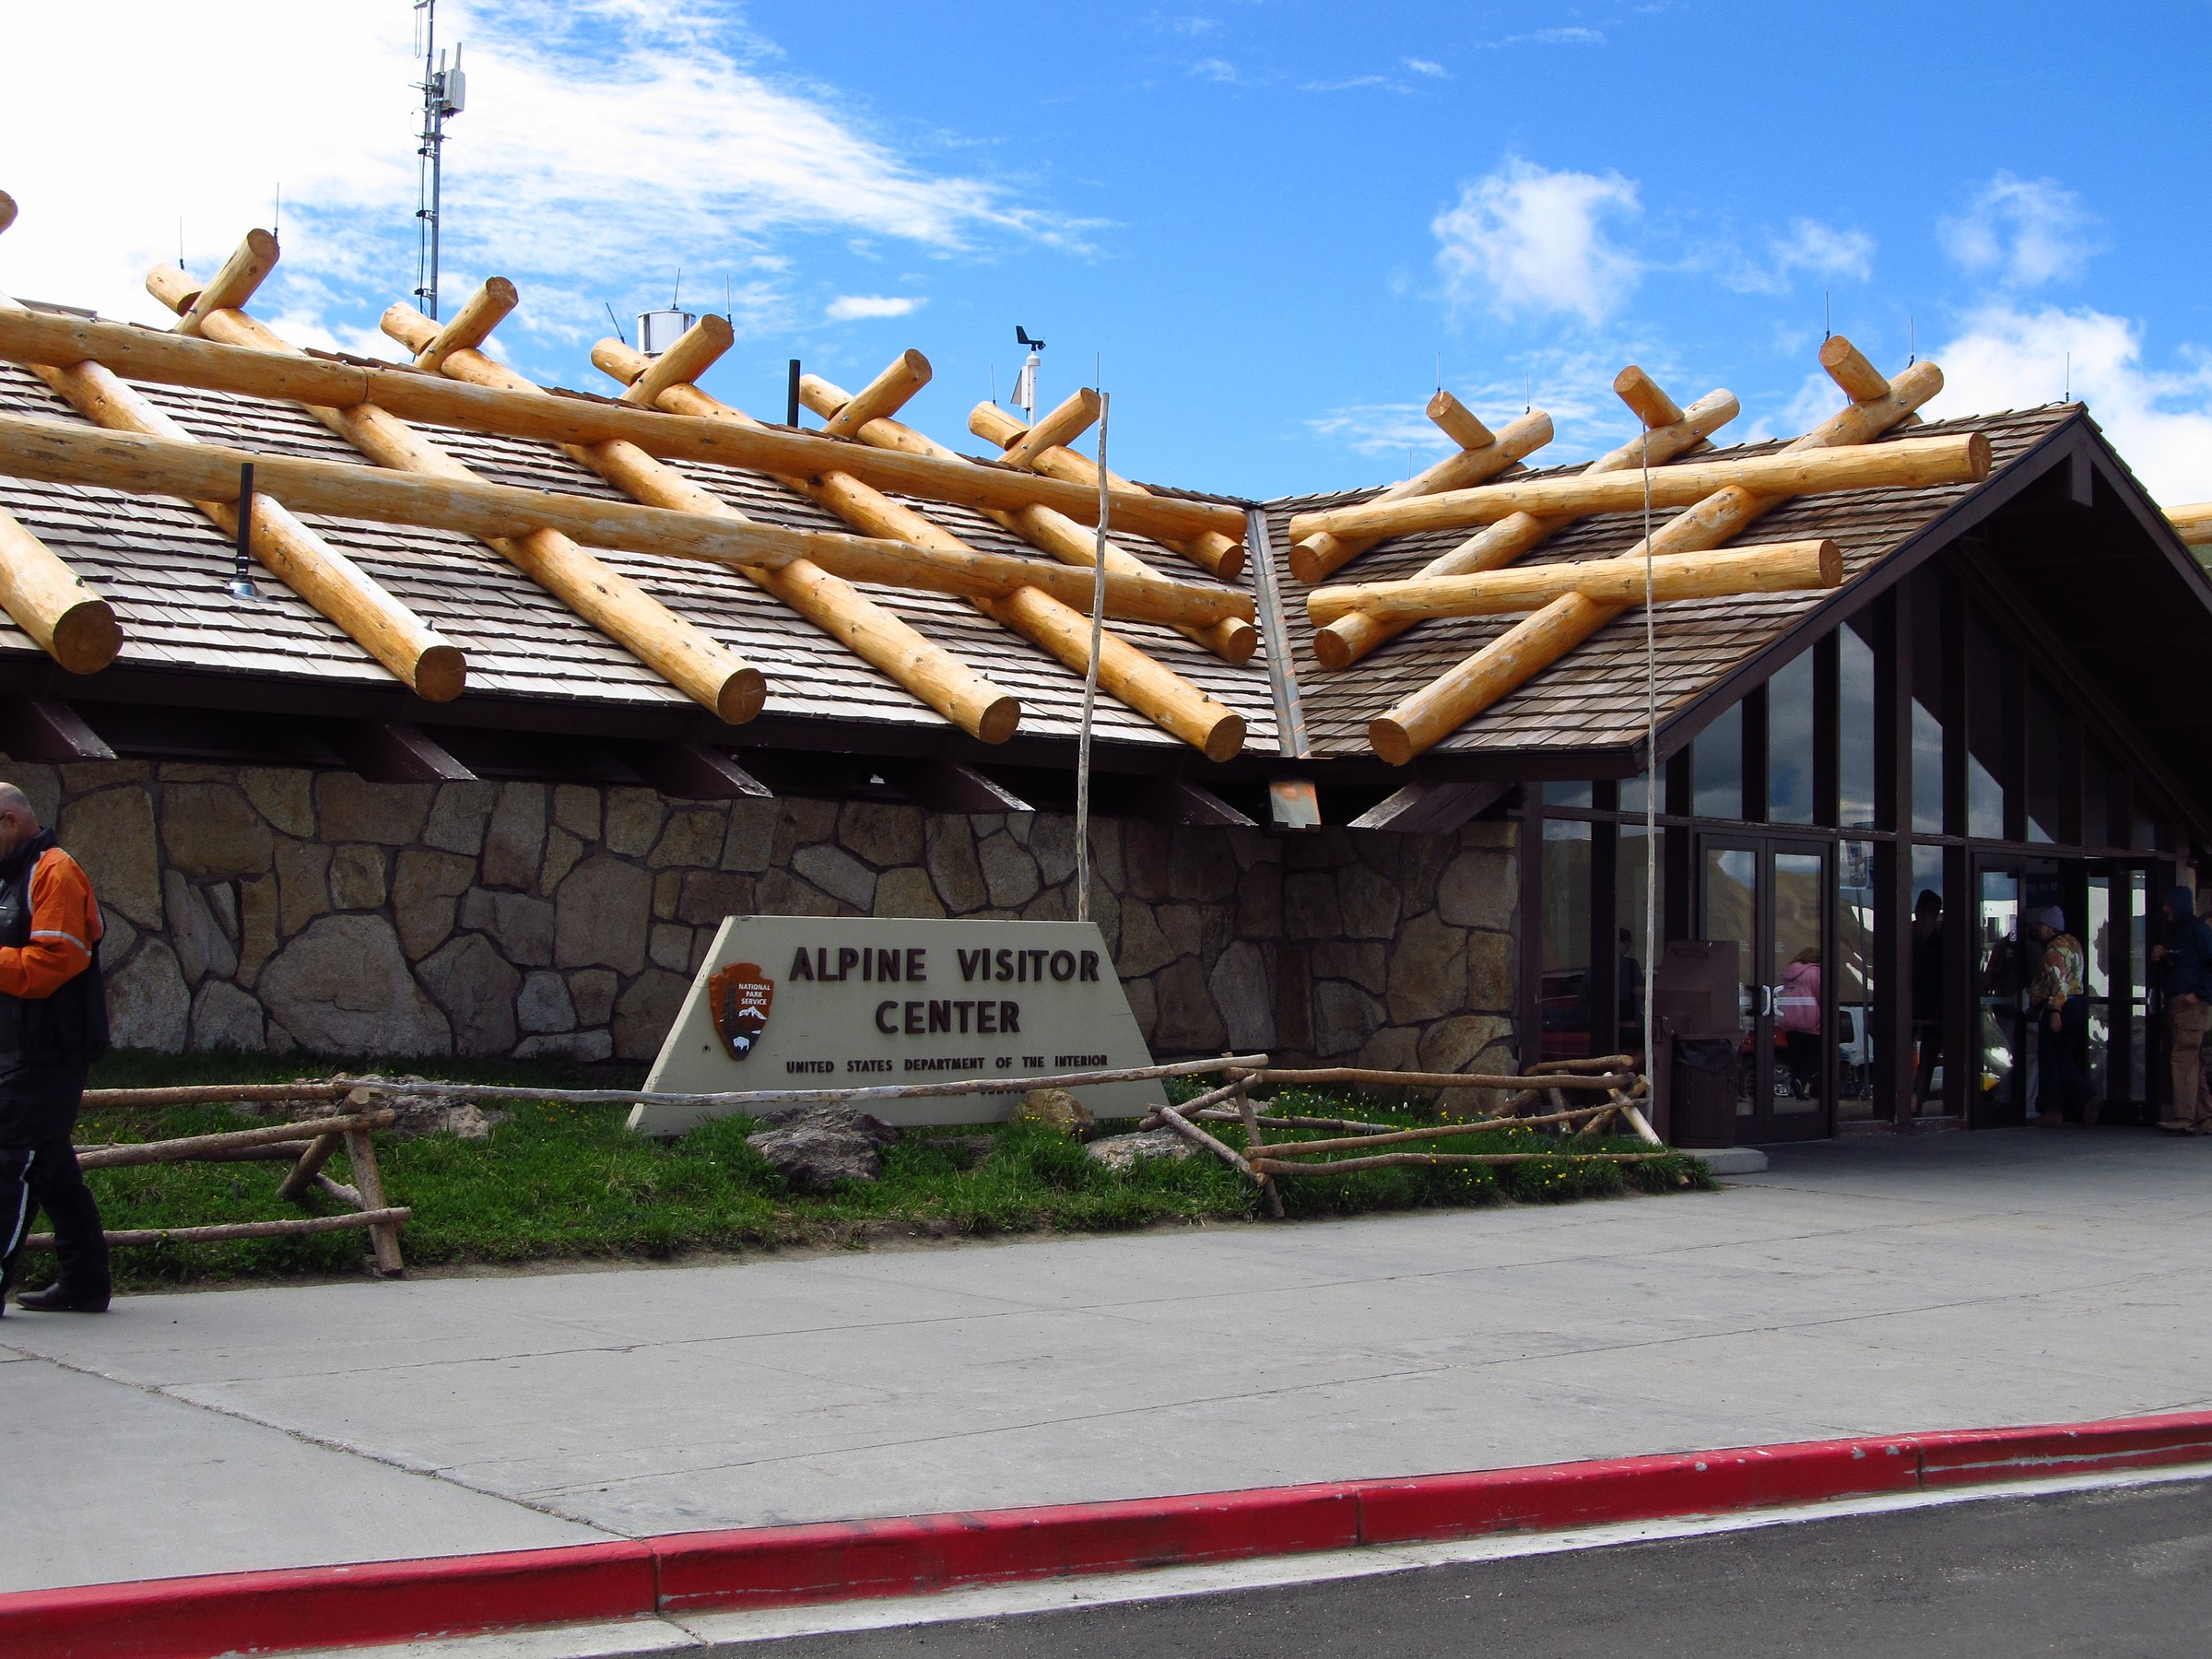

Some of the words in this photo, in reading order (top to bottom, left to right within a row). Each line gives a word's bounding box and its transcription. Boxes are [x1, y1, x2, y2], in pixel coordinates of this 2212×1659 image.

[789, 947, 927, 982] ALPINE
[957, 947, 1100, 982] VISITOR
[738, 982, 771, 991] NATIONAL
[876, 1000, 1021, 1034] CENTER
[786, 1061, 835, 1073] UNITED
[847, 1060, 893, 1072] STATES
[904, 1057, 985, 1071] DEPARTMENT
[995, 1056, 1013, 1068] OF
[1022, 1056, 1045, 1067] THE
[1054, 1054, 1108, 1067] INTERIOR
